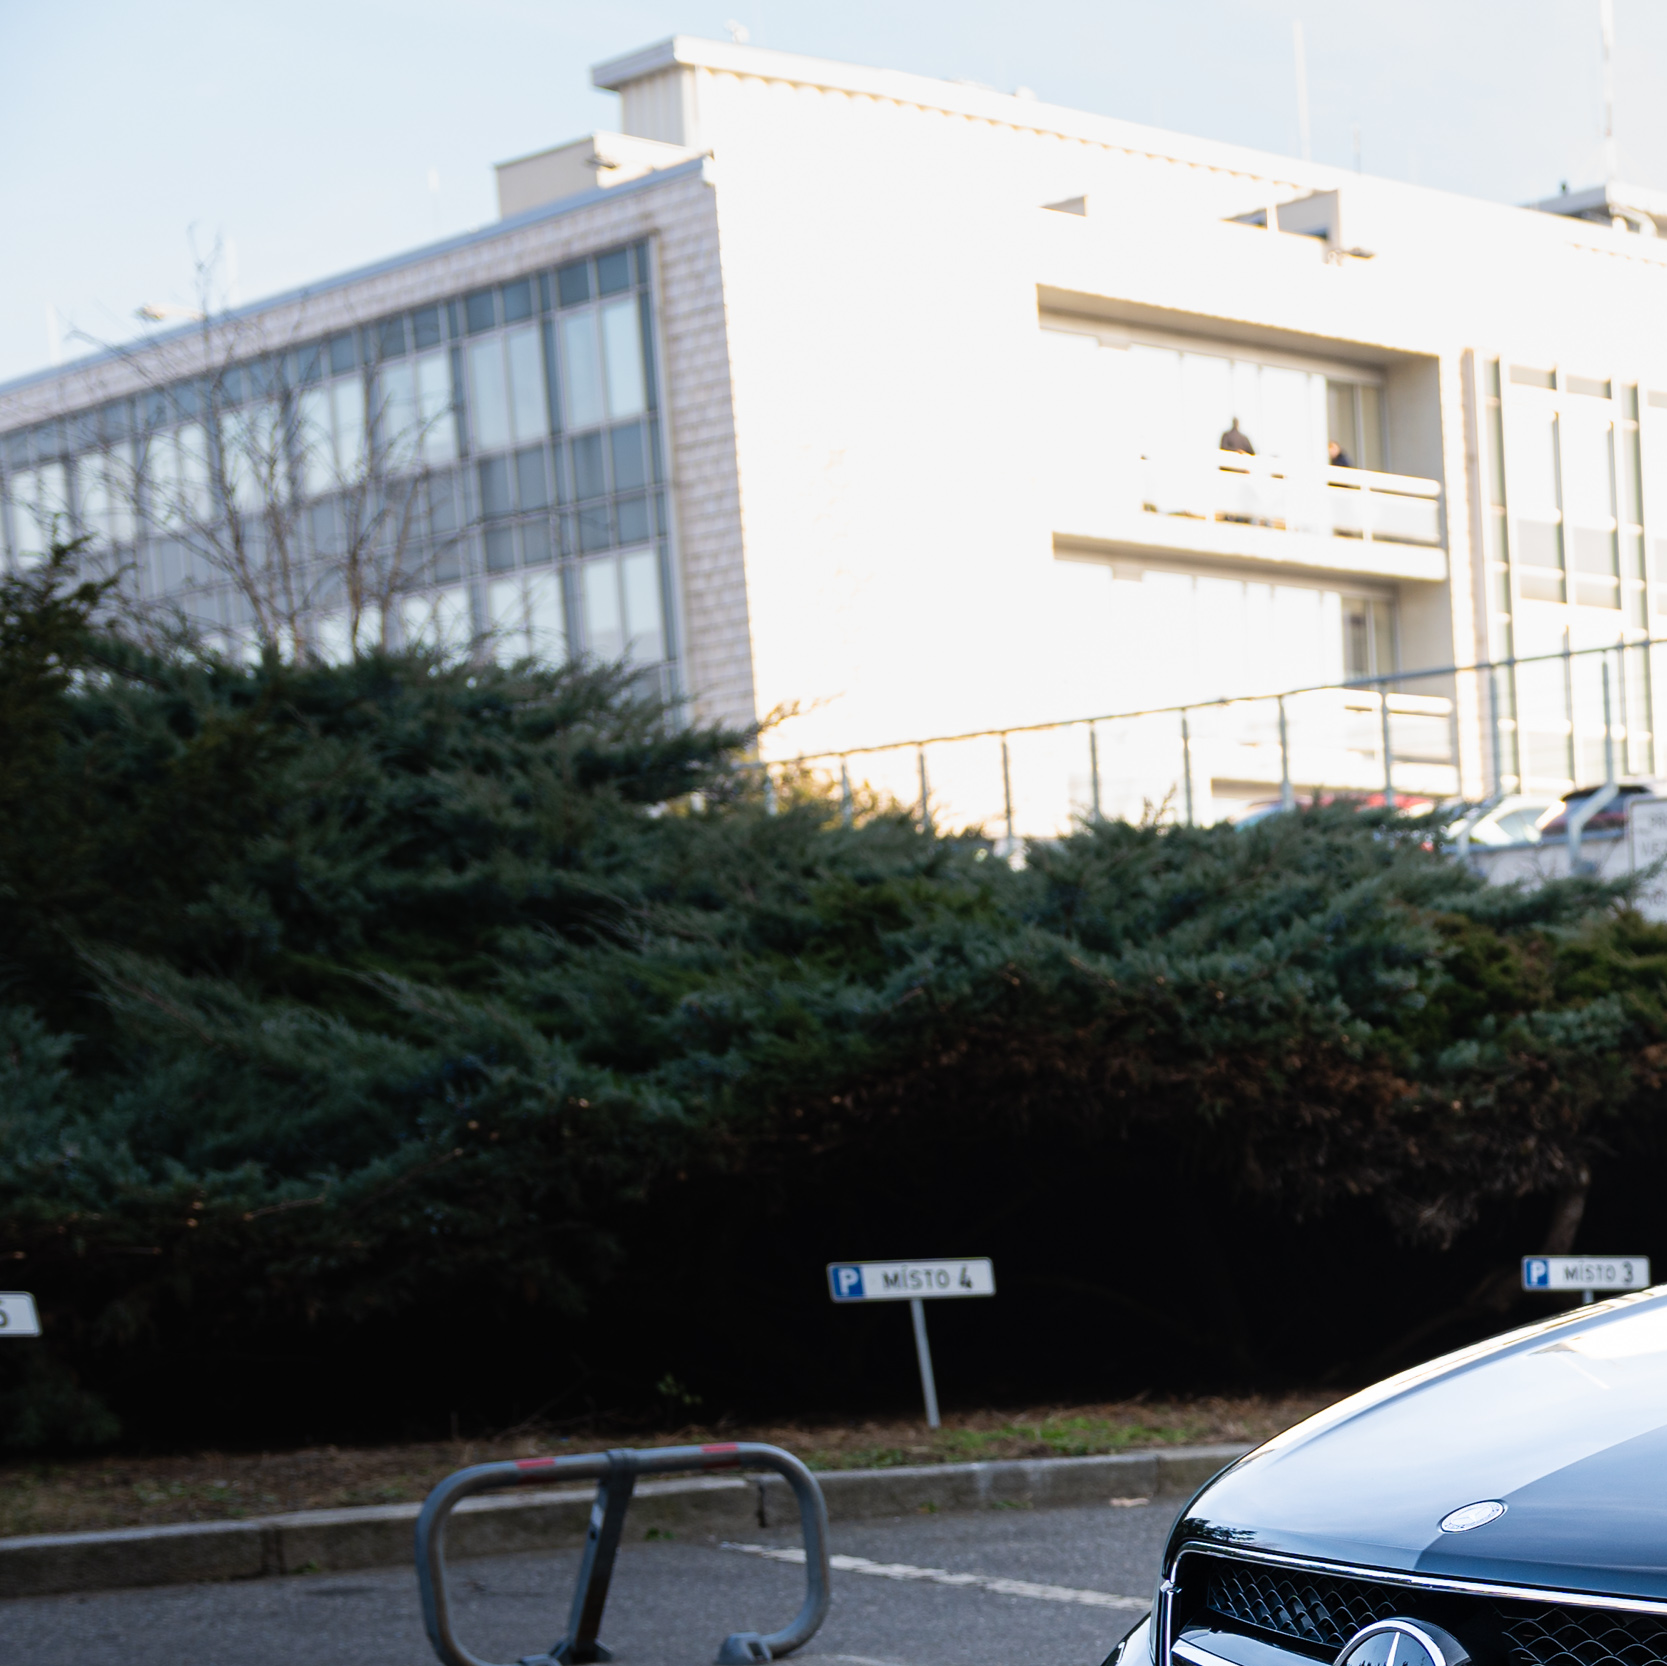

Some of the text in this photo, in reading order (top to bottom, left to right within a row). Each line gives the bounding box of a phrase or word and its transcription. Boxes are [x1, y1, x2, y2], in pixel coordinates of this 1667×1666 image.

[838, 1265, 859, 1296] P
[958, 1264, 973, 1289] 4
[1530, 1260, 1547, 1285] P
[1622, 1260, 1634, 1286] 3
